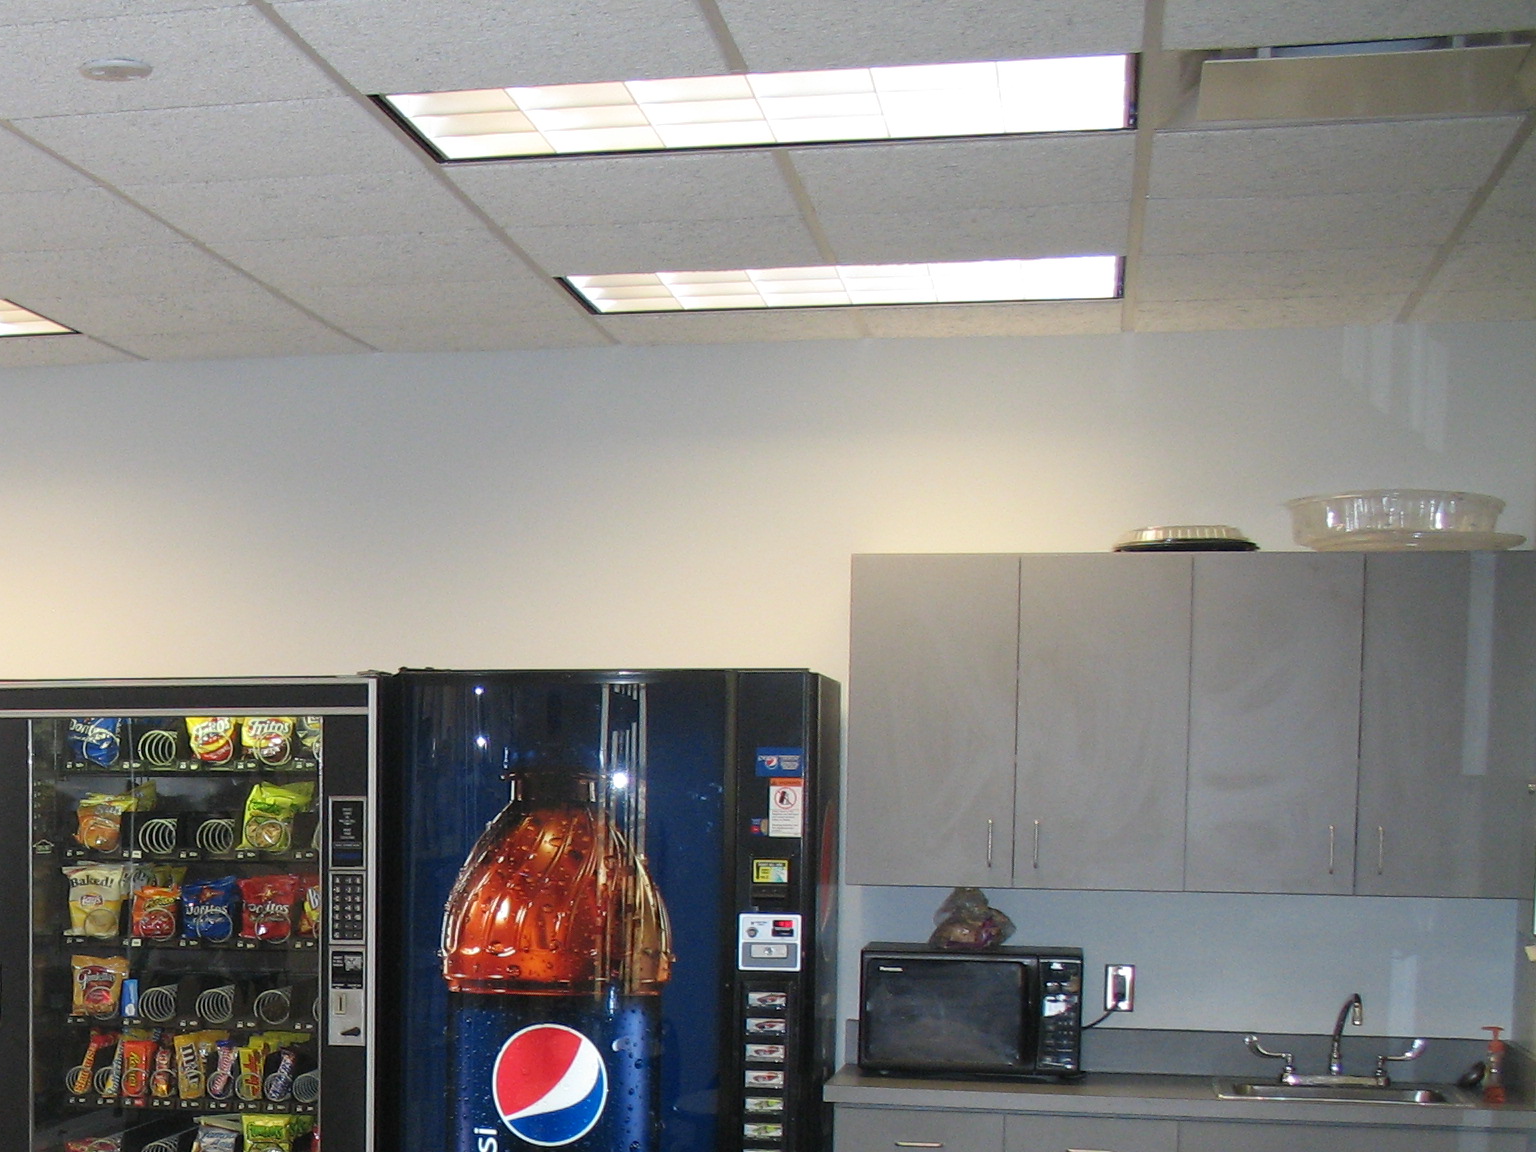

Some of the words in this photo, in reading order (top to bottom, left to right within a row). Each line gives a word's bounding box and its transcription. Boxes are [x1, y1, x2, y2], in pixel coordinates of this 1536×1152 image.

[249, 719, 291, 738] Fritos
[68, 873, 114, 889] Baked!
[248, 901, 290, 915] Doitos
